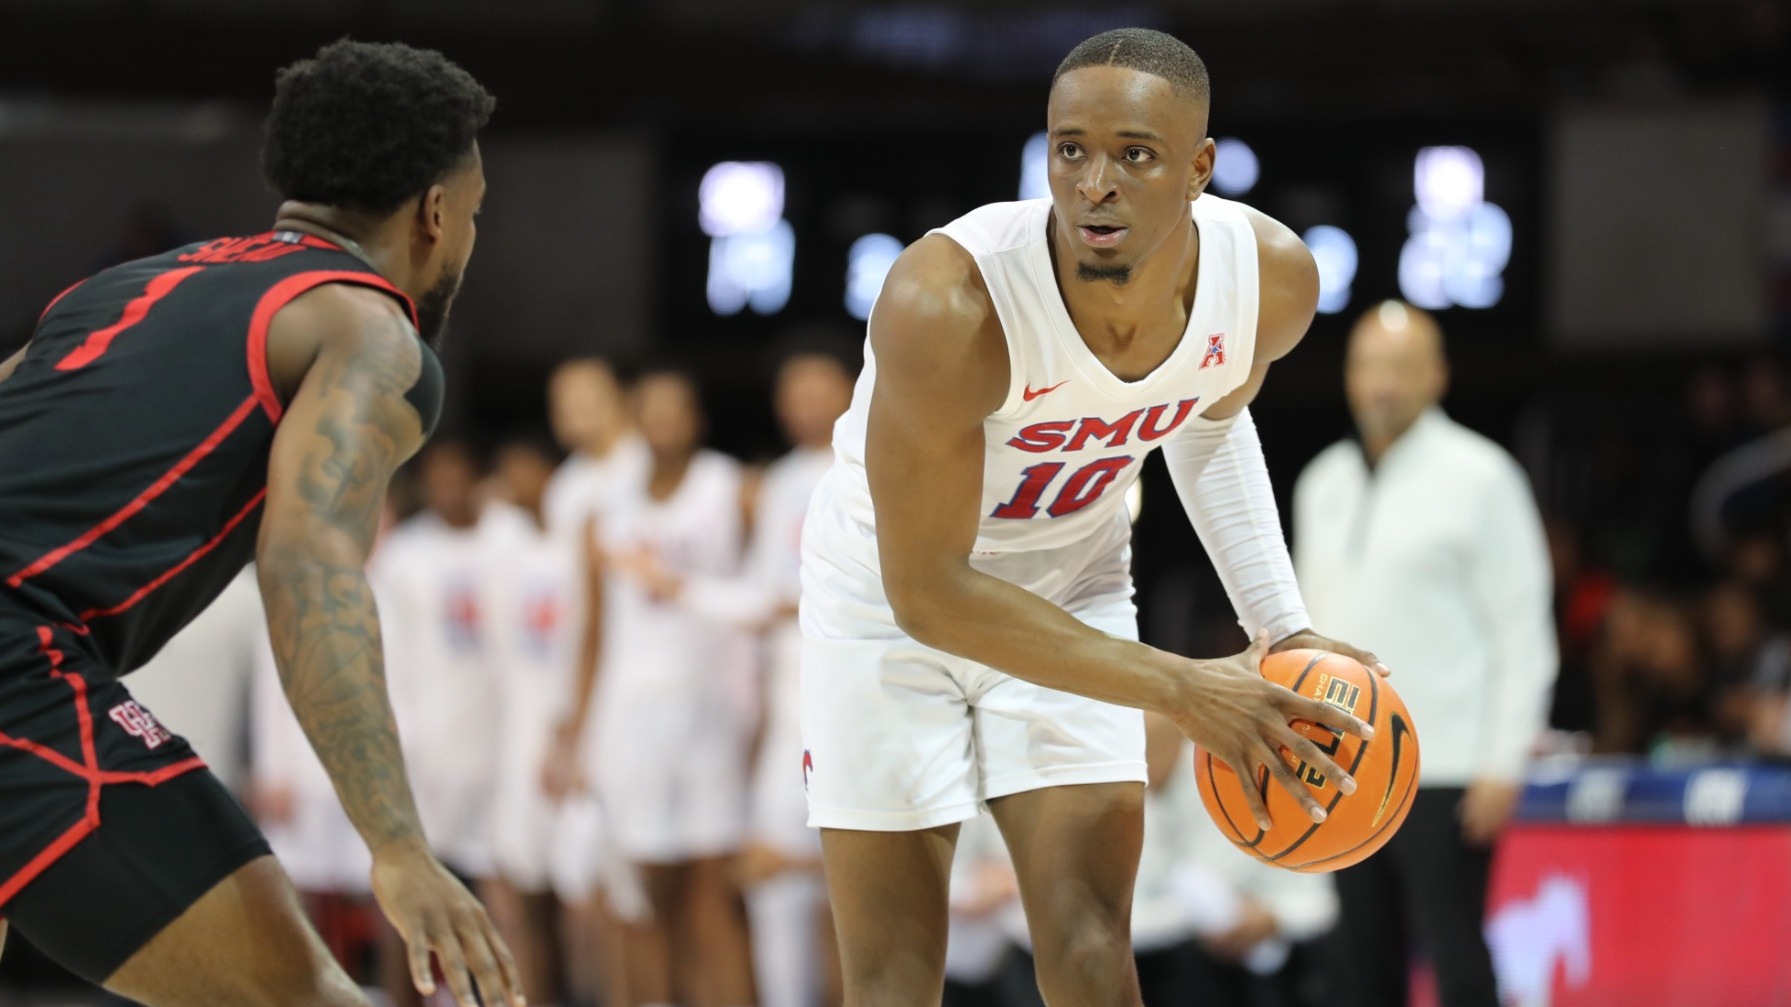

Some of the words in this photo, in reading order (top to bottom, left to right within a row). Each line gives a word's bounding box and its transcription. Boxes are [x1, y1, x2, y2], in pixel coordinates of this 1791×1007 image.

[53, 265, 205, 372] 1
[1005, 396, 1200, 453] SMU
[989, 455, 1135, 519] 10
